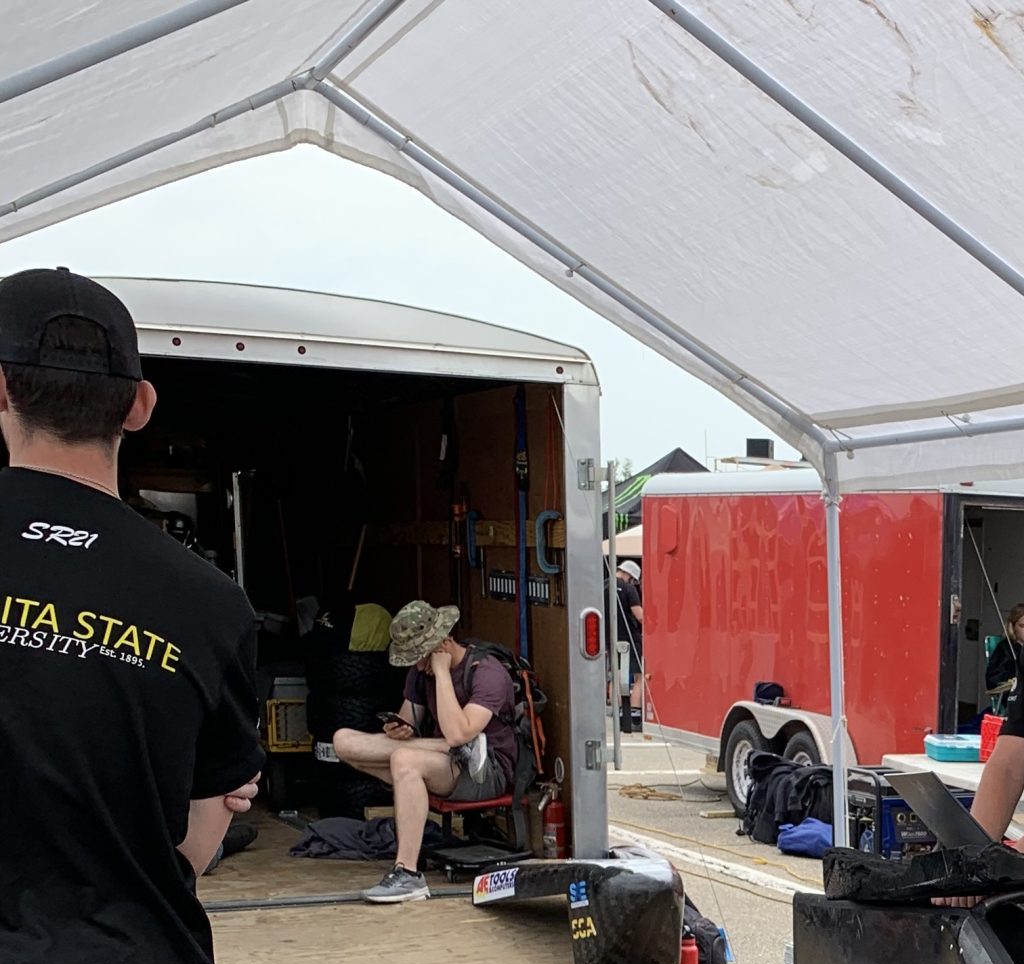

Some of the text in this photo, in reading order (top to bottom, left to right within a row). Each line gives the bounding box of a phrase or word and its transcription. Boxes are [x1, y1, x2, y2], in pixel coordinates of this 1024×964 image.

[22, 521, 98, 549] SR21
[73, 611, 181, 673] STATE
[119, 652, 145, 669] 1895.
[489, 869, 517, 887] TOOLS
